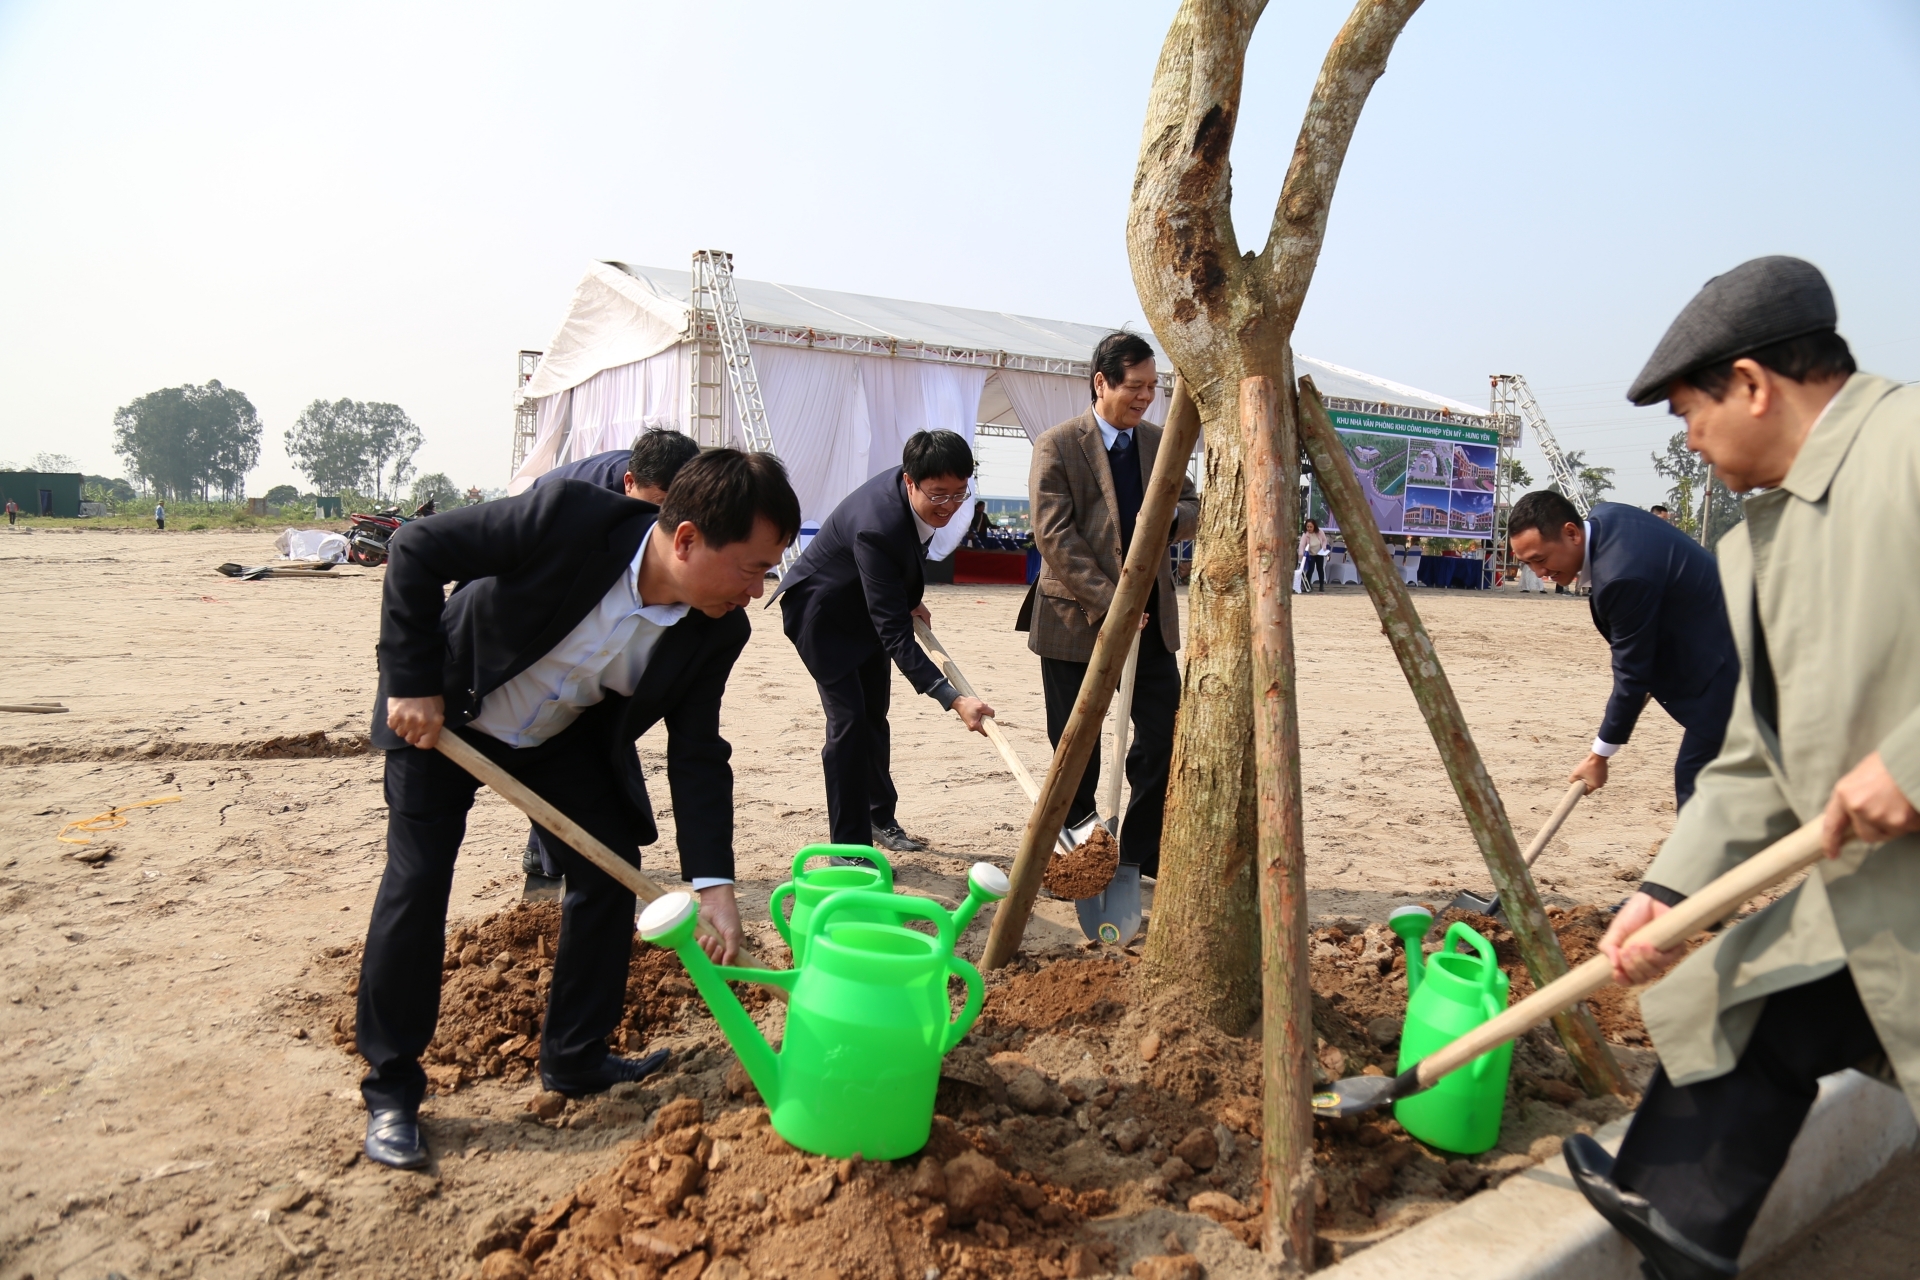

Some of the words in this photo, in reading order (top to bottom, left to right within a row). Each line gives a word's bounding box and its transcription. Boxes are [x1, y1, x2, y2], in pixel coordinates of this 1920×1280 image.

[1350, 418, 1362, 426] NHÀ
[1395, 423, 1406, 431] KHU
[1407, 424, 1421, 433] CÔNG
